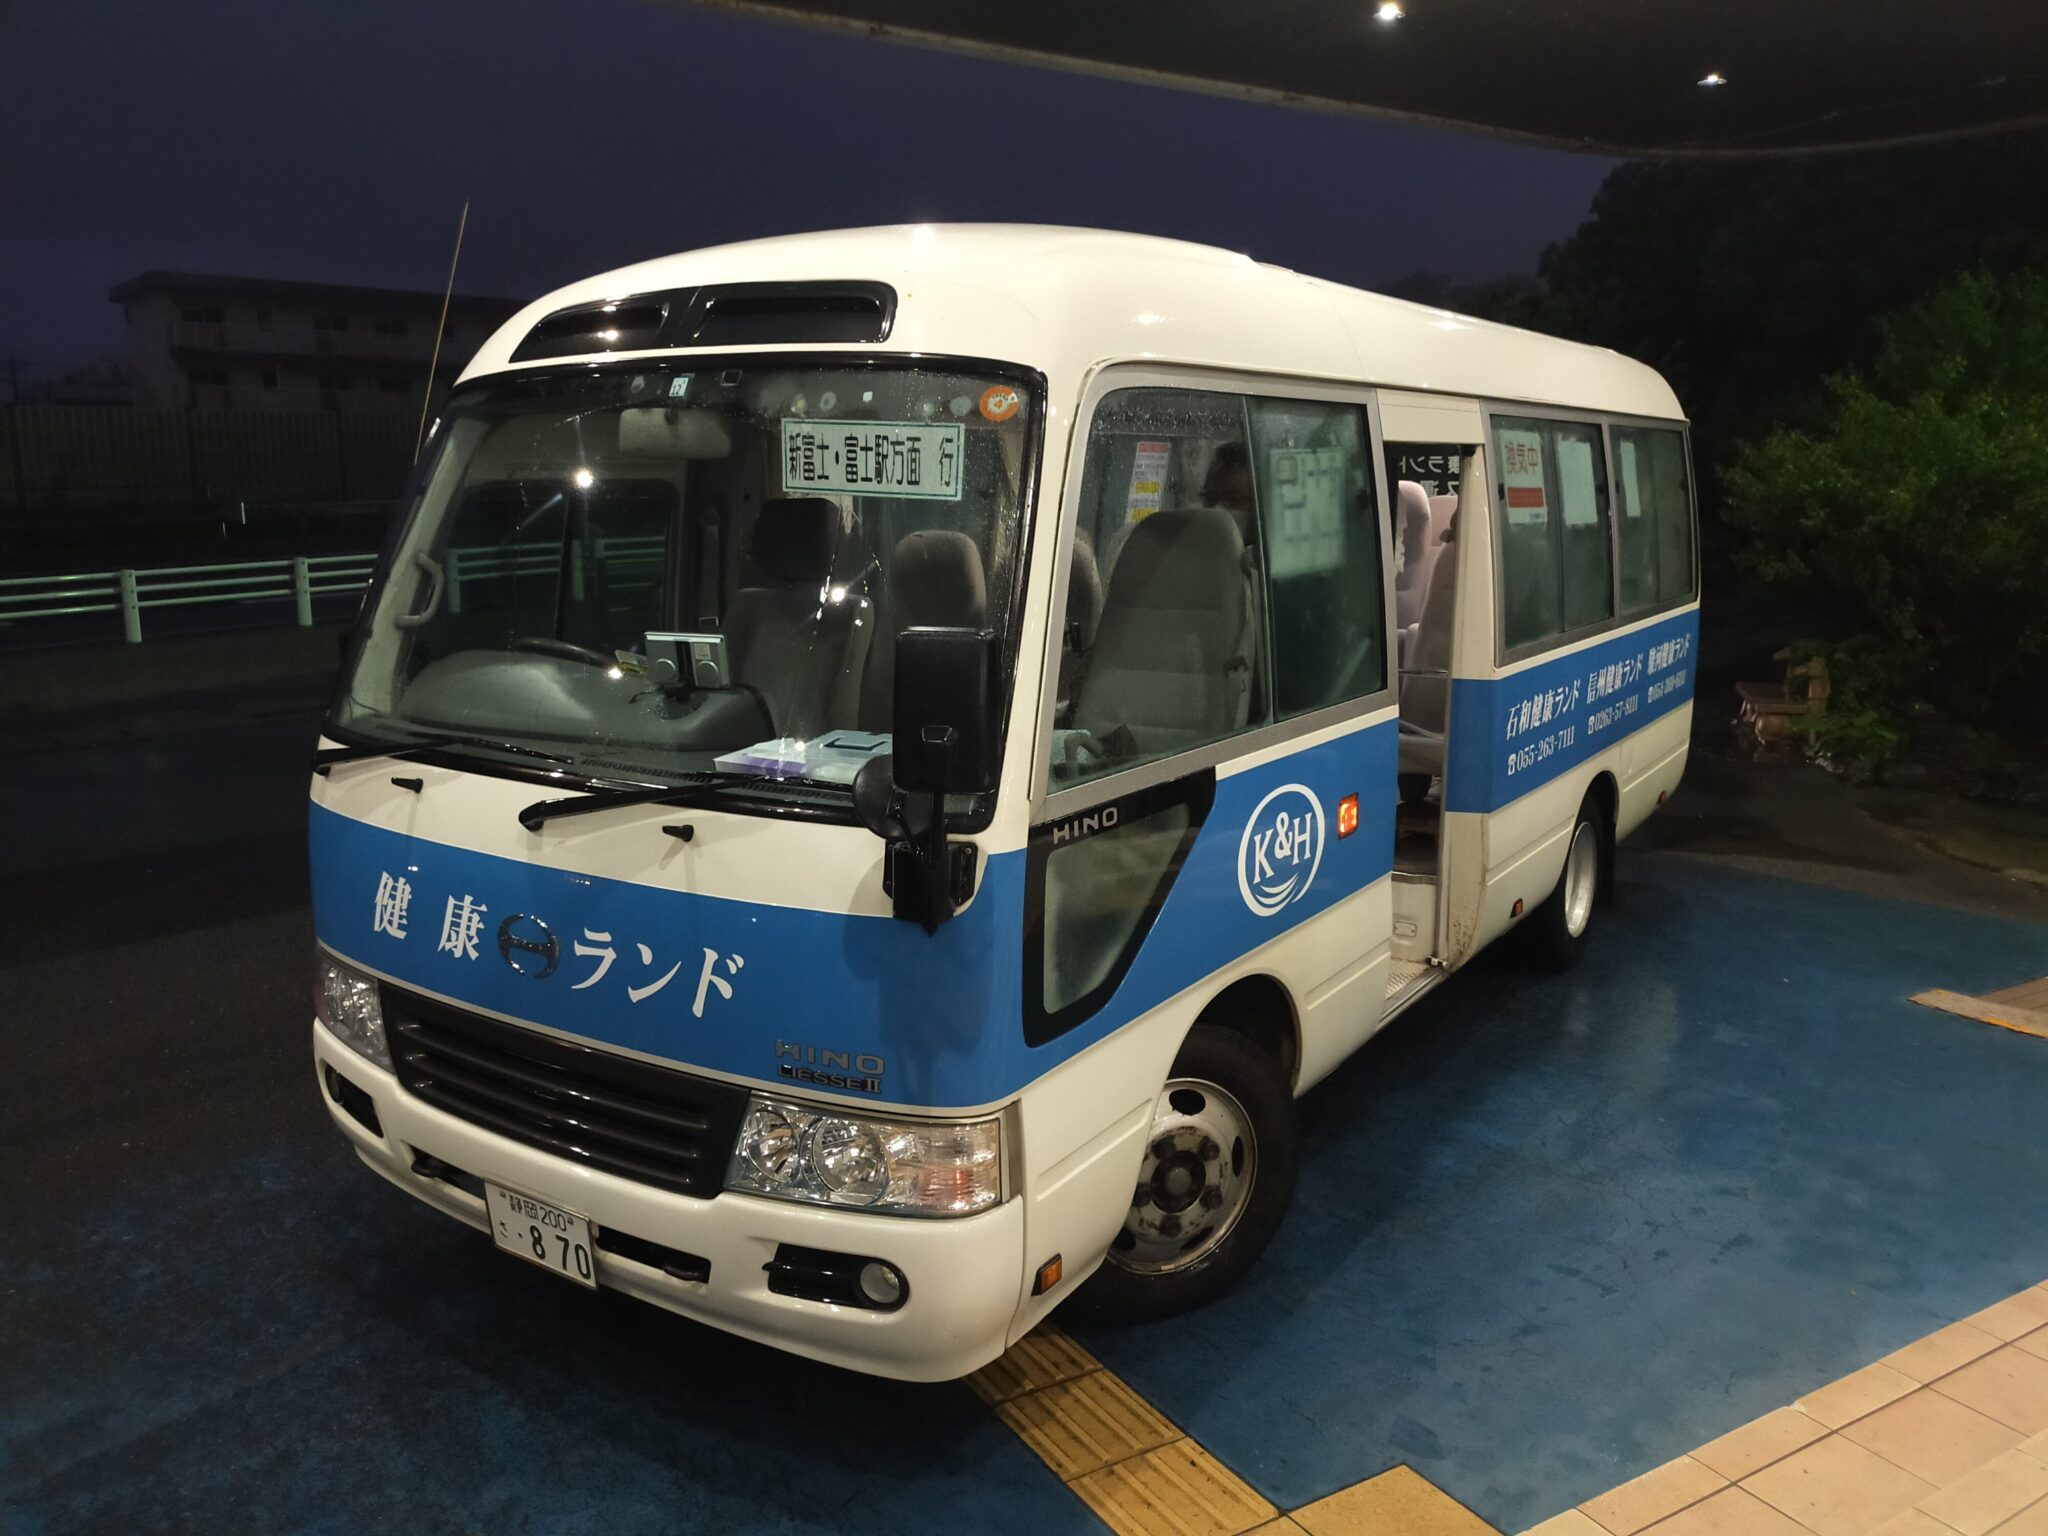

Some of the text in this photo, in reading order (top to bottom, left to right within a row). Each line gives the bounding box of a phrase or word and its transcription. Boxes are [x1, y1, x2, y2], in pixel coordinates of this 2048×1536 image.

[788, 433, 954, 488] 新富士・富士駅方面 行
[1506, 679, 1581, 741] 石和健康ランド
[1516, 725, 1575, 772] 055-263-7111
[1052, 806, 1119, 846] HINO
[1253, 812, 1313, 885] K&H
[775, 1039, 886, 1076] HINO
